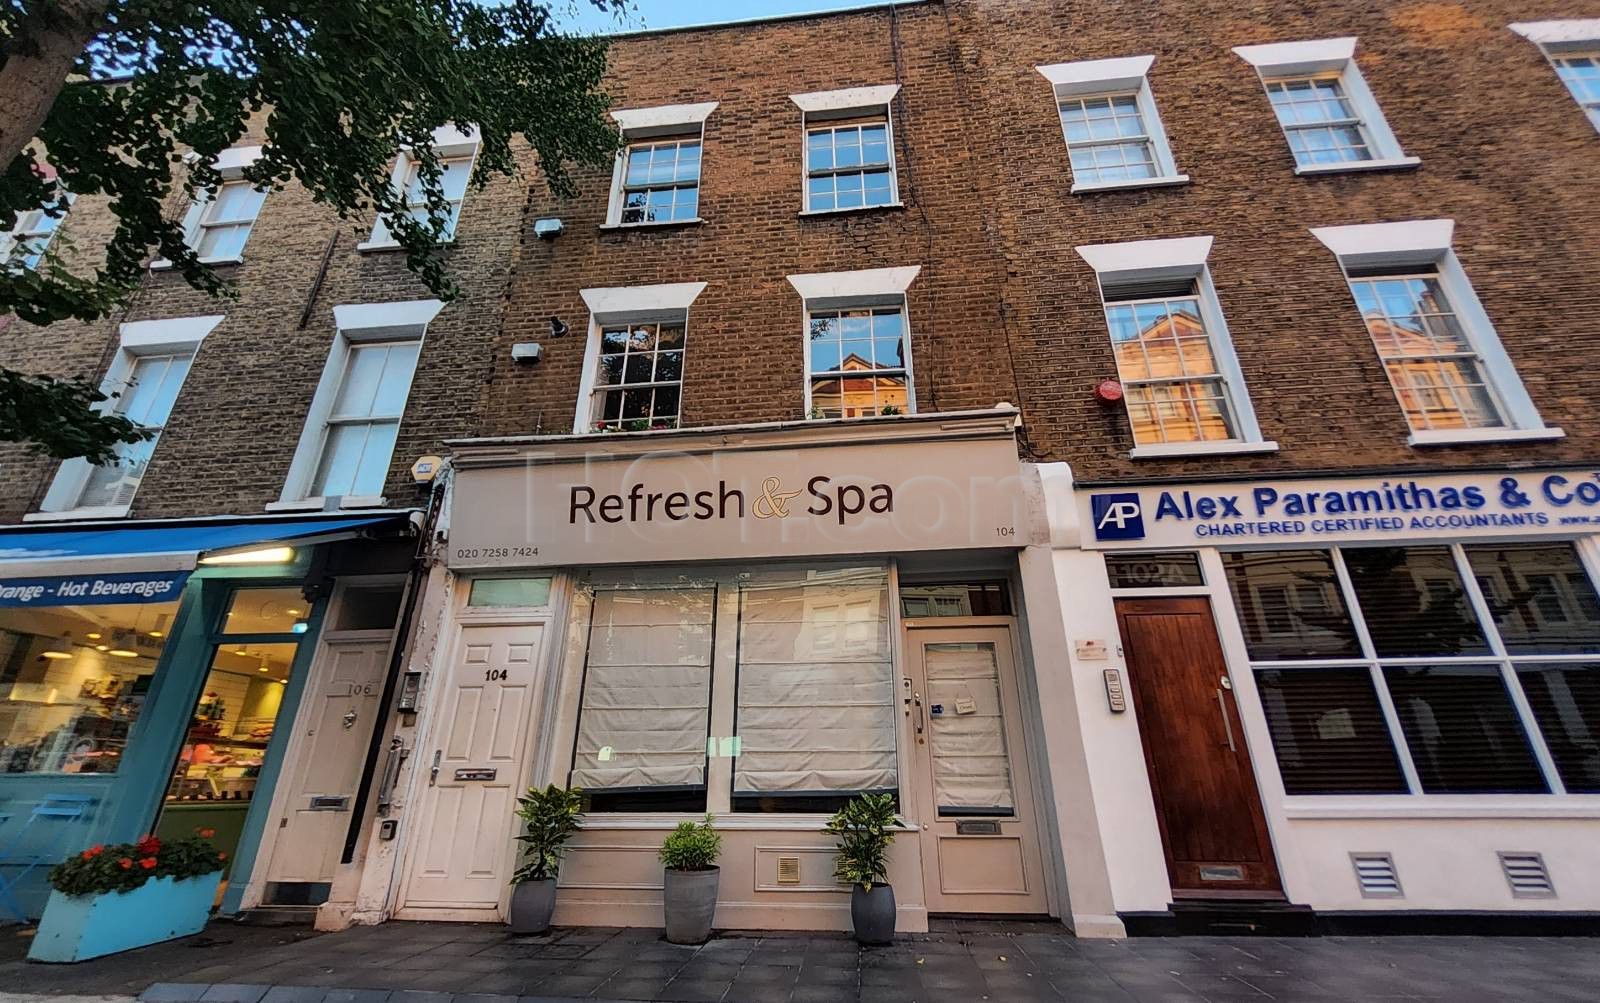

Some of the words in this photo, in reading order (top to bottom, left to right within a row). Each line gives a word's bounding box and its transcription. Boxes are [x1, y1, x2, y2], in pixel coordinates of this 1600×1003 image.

[569, 480, 744, 524] Refresh
[752, 476, 803, 519] &
[807, 476, 894, 525] Spa
[1155, 490, 1243, 521] Alex
[1253, 481, 1486, 517] Paramithas
[1500, 477, 1532, 508] &
[1098, 502, 1140, 530] AP
[1196, 520, 1305, 538] CHARTERED
[1311, 516, 1404, 534] CERTIFIED
[1410, 511, 1549, 530] ACCOUNTANTS
[996, 527, 1015, 537] 104
[457, 549, 478, 559] 020
[482, 548, 508, 558] 7258
[512, 547, 539, 557] 7424
[57, 581, 87, 597] Hot
[90, 580, 174, 597] Beverages
[485, 669, 508, 681] 104
[348, 683, 372, 696] 106
